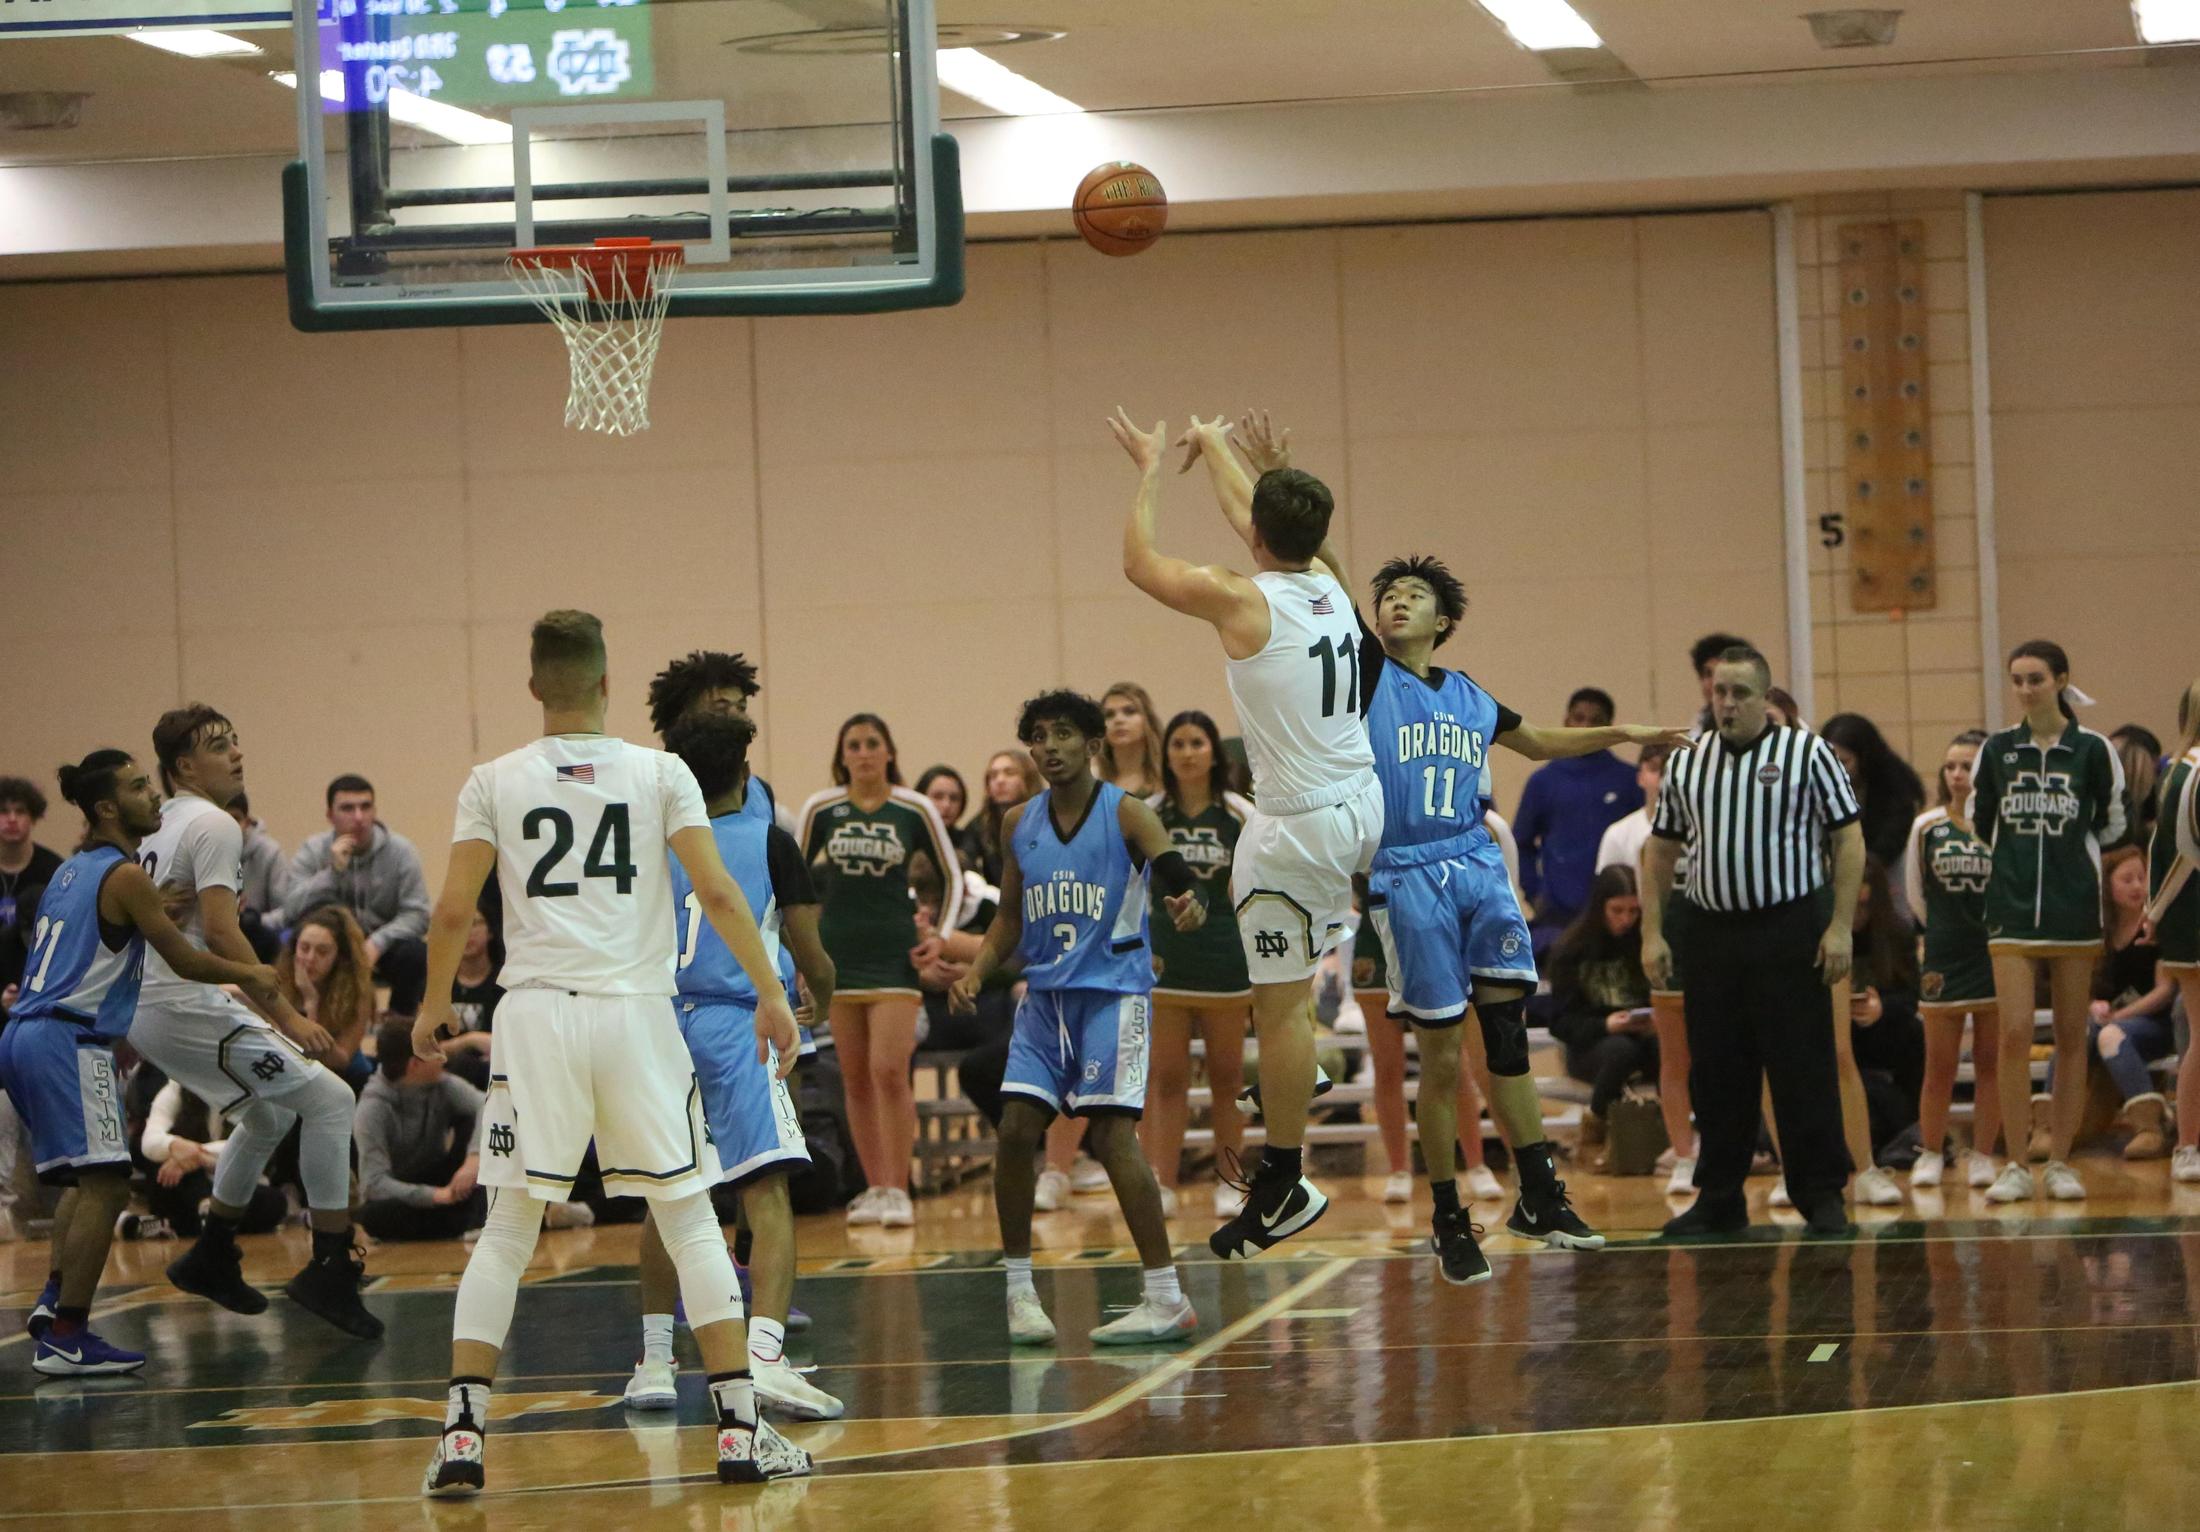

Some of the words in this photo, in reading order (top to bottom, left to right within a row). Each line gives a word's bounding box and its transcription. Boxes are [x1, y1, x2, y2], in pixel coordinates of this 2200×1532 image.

[1819, 513, 1845, 549] 5
[1308, 632, 1358, 718] 11
[1398, 721, 1483, 769] DRAGONS
[1423, 765, 1457, 818] 11
[2001, 792, 2080, 821] COUGARS
[522, 803, 638, 898] 24
[827, 838, 906, 864] COUGARS
[1025, 881, 1106, 924] DRAGONS
